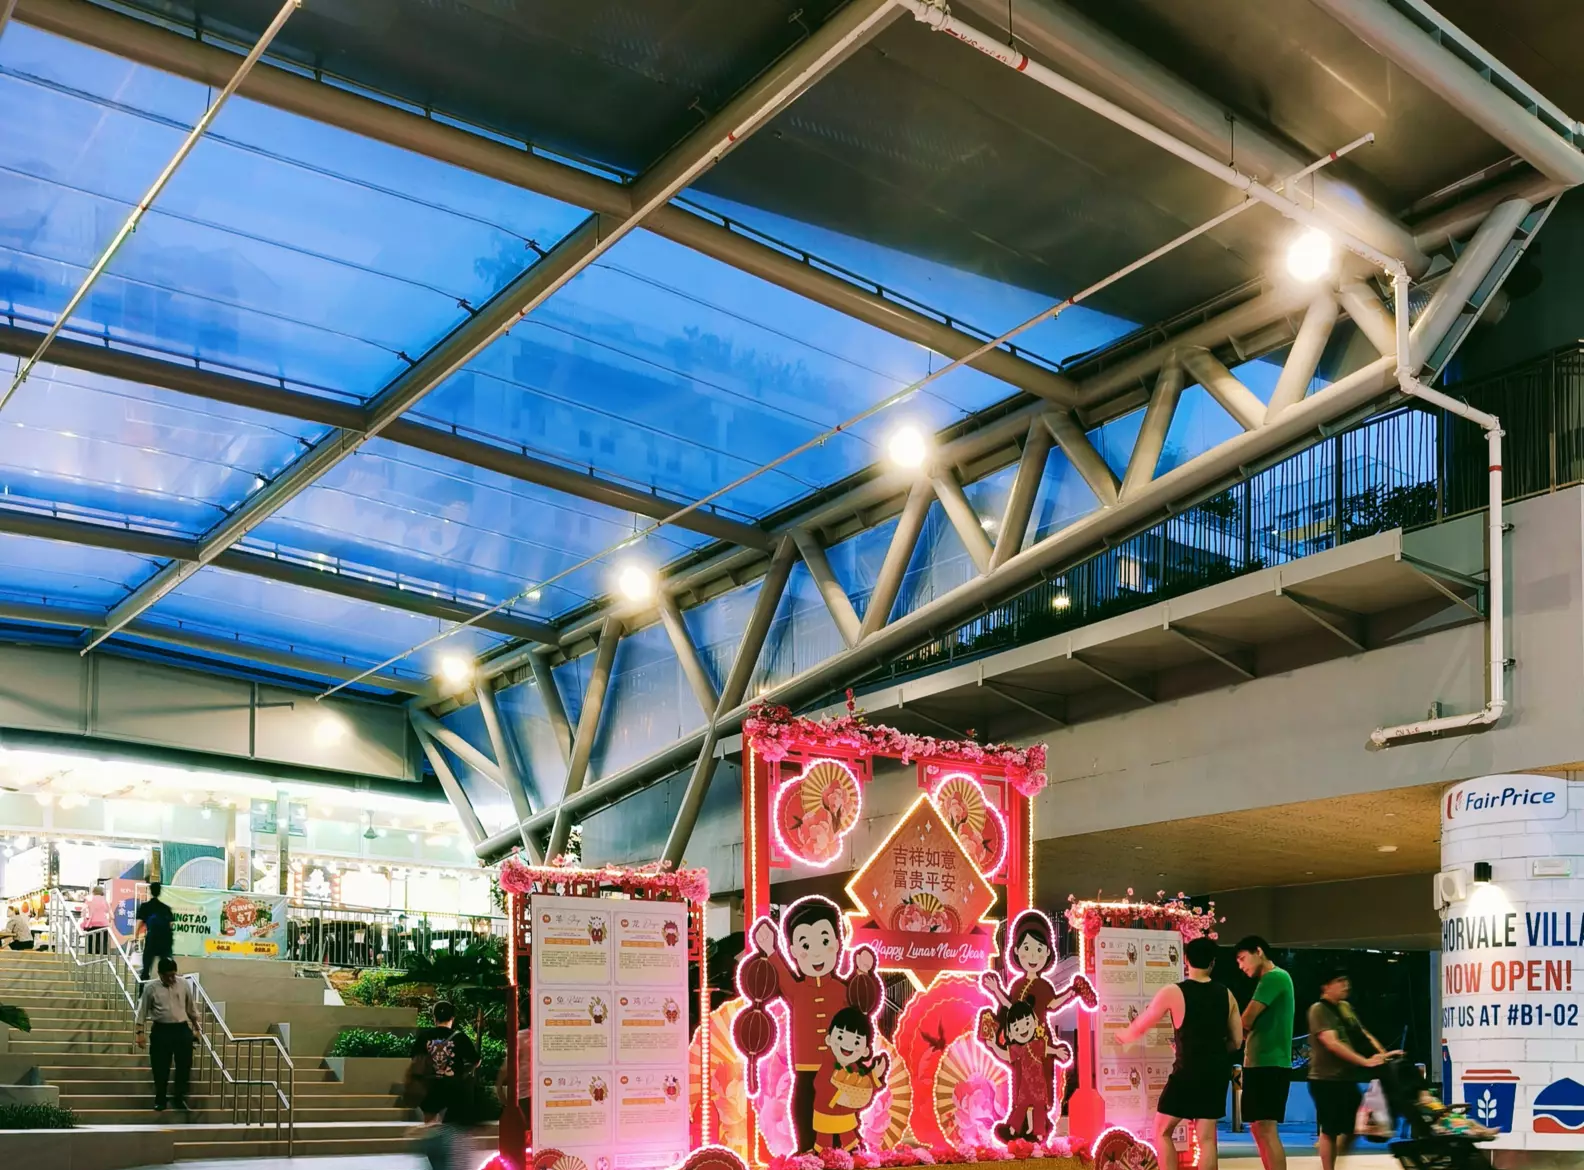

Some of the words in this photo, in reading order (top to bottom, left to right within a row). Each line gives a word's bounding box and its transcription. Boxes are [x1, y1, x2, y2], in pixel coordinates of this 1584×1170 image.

[1465, 788, 1555, 811] FairPrice
[893, 845, 956, 869] 吉祥如意
[893, 868, 956, 893] 富贵平安
[230, 902, 255, 913] Save
[236, 911, 252, 923] $7
[1442, 912, 1517, 953] HORVALE
[870, 939, 904, 961] Happy
[906, 941, 936, 959] Lunar
[936, 942, 959, 959] New
[958, 943, 985, 963] Year
[1446, 962, 1482, 994] NOW
[1491, 960, 1572, 991] OPEN!
[1442, 1007, 1455, 1028] SIT
[1458, 1005, 1474, 1027] US
[1480, 1004, 1501, 1026] AT
[1507, 1003, 1578, 1026] #B1-02
